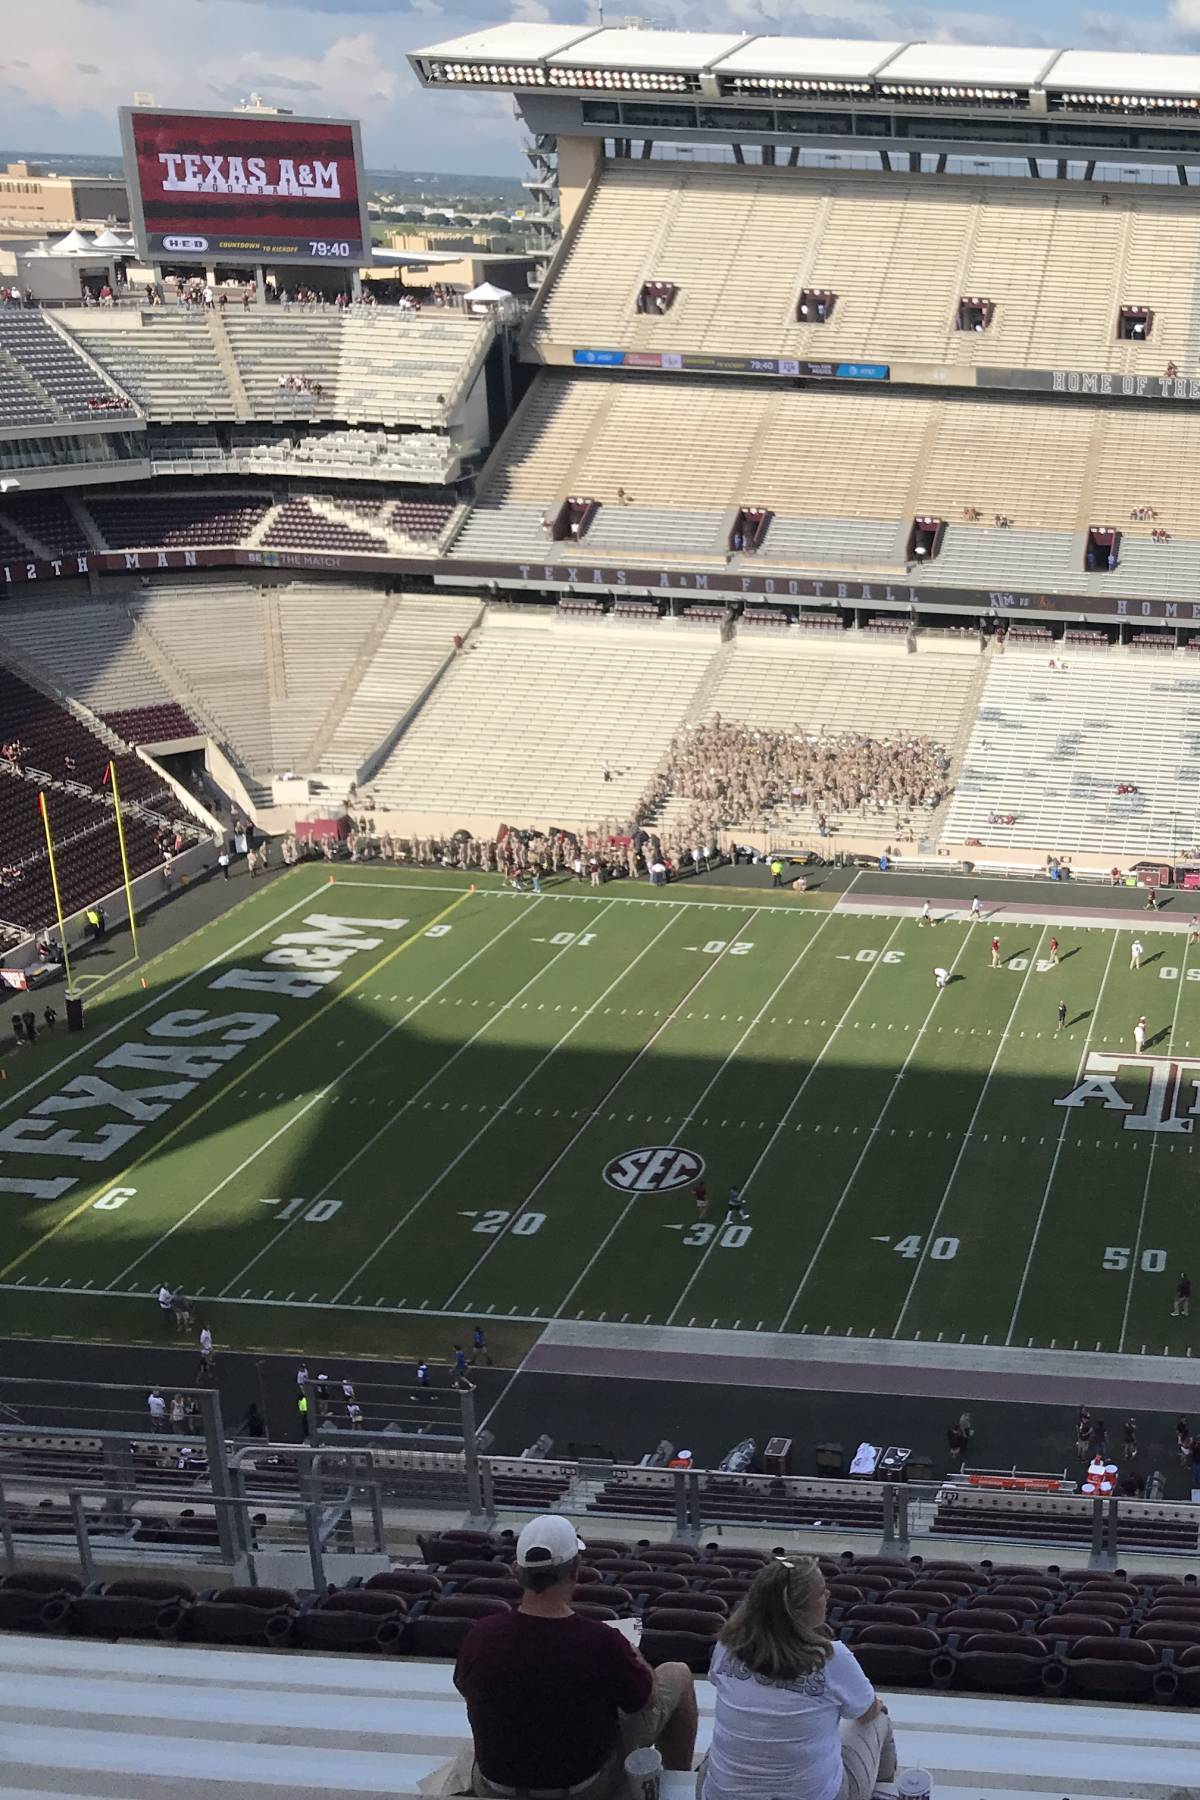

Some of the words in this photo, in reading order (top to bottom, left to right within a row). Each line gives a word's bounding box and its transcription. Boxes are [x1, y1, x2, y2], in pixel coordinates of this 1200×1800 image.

[158, 153, 267, 187] TEXAS
[279, 159, 340, 188] A&M
[197, 183, 308, 196] FOOTBALL
[219, 241, 261, 249] COUNTDOWN
[309, 242, 350, 257] 79:40
[1052, 372, 1112, 393] HOME
[1122, 375, 1149, 396] OF
[1158, 377, 1200, 398] THE
[3, 558, 89, 582] 12TH
[125, 551, 197, 569] MAN
[248, 553, 262, 563] BE
[281, 555, 306, 566] THE
[308, 556, 342, 568] MATCH
[519, 565, 627, 585] TEXAS
[659, 573, 709, 590] A&M
[741, 576, 919, 603] FOOTBALL
[1117, 600, 1200, 619] HOME
[549, 932, 597, 946] 10
[702, 941, 754, 955] 20
[208, 913, 409, 998] A&M
[855, 950, 905, 964] 30
[611, 1149, 701, 1190] SEC
[92, 1188, 137, 1210] G
[275, 1199, 343, 1222] 10
[473, 1211, 547, 1236] 20
[683, 1224, 753, 1249] 30
[893, 1235, 961, 1260] 40
[1102, 1247, 1168, 1273] 50
